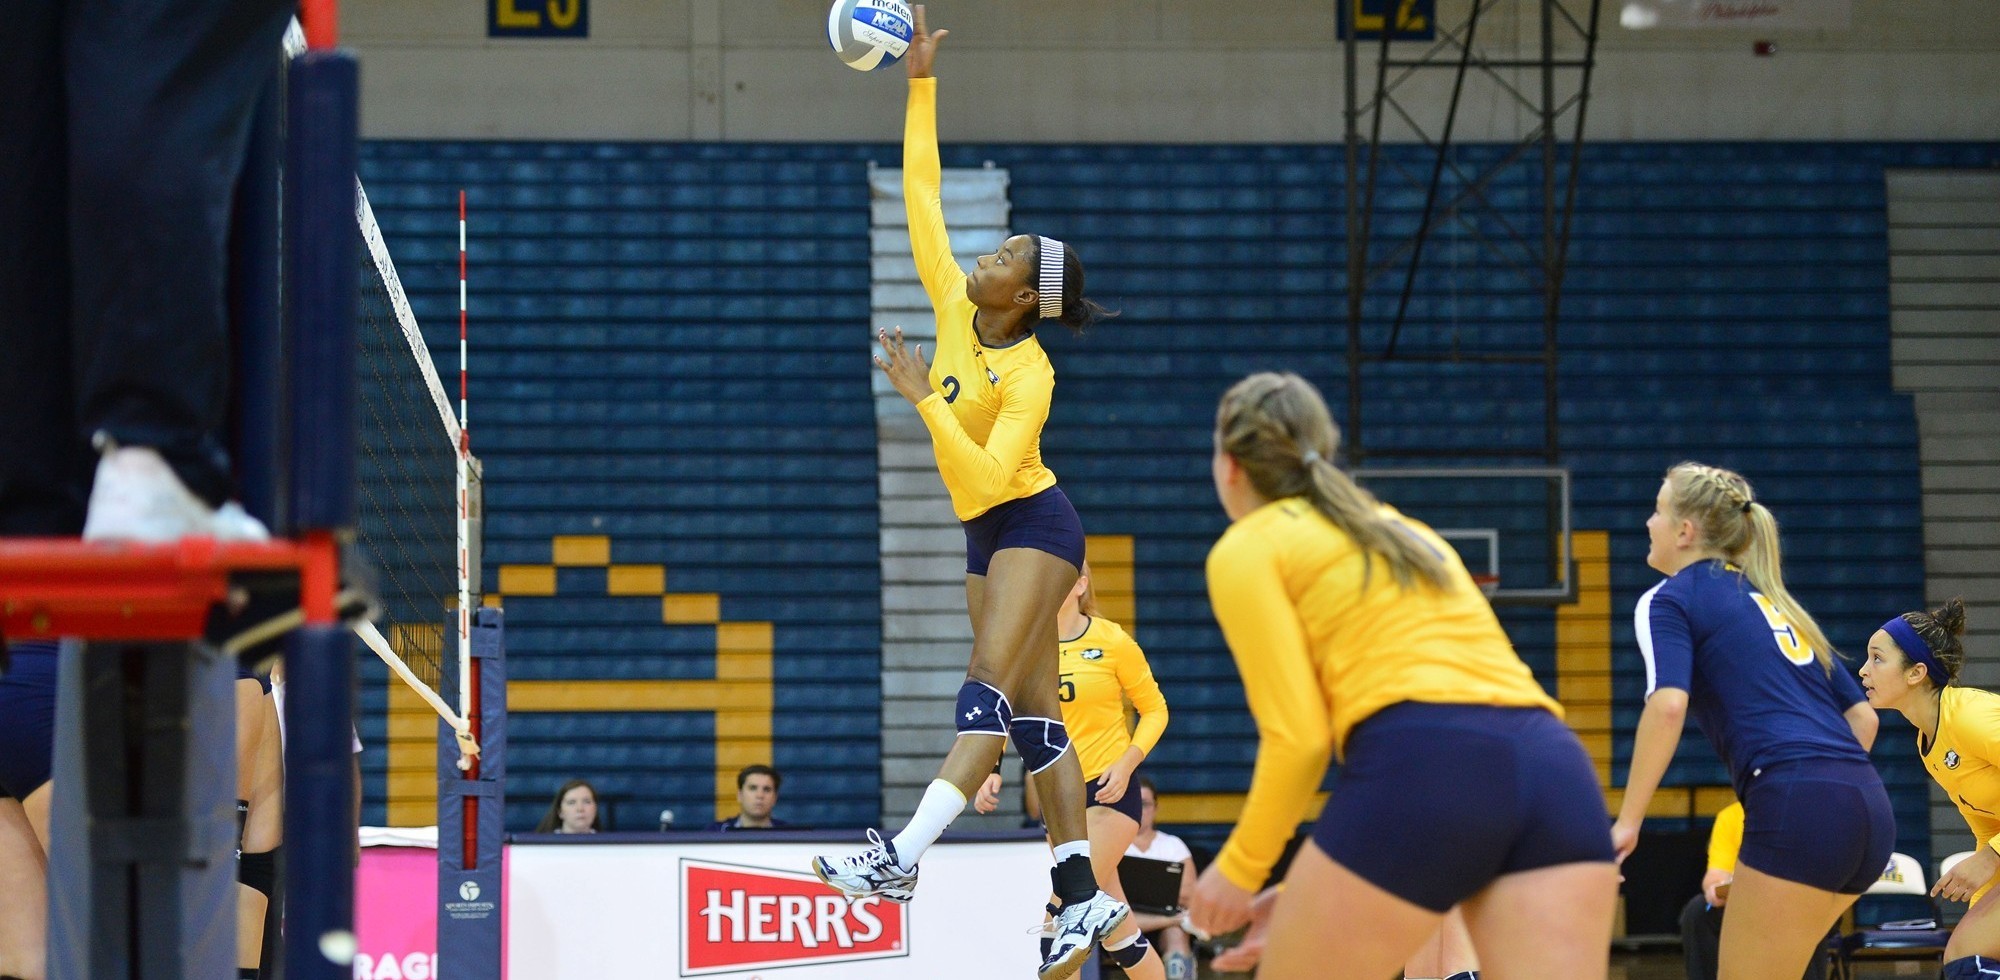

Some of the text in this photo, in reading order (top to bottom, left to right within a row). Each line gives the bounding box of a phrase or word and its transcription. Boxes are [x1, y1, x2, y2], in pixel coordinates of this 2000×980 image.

[871, 11, 908, 37] NCAA
[872, 0, 912, 24] molten
[1058, 672, 1076, 703] 5
[353, 951, 438, 980] RAG
